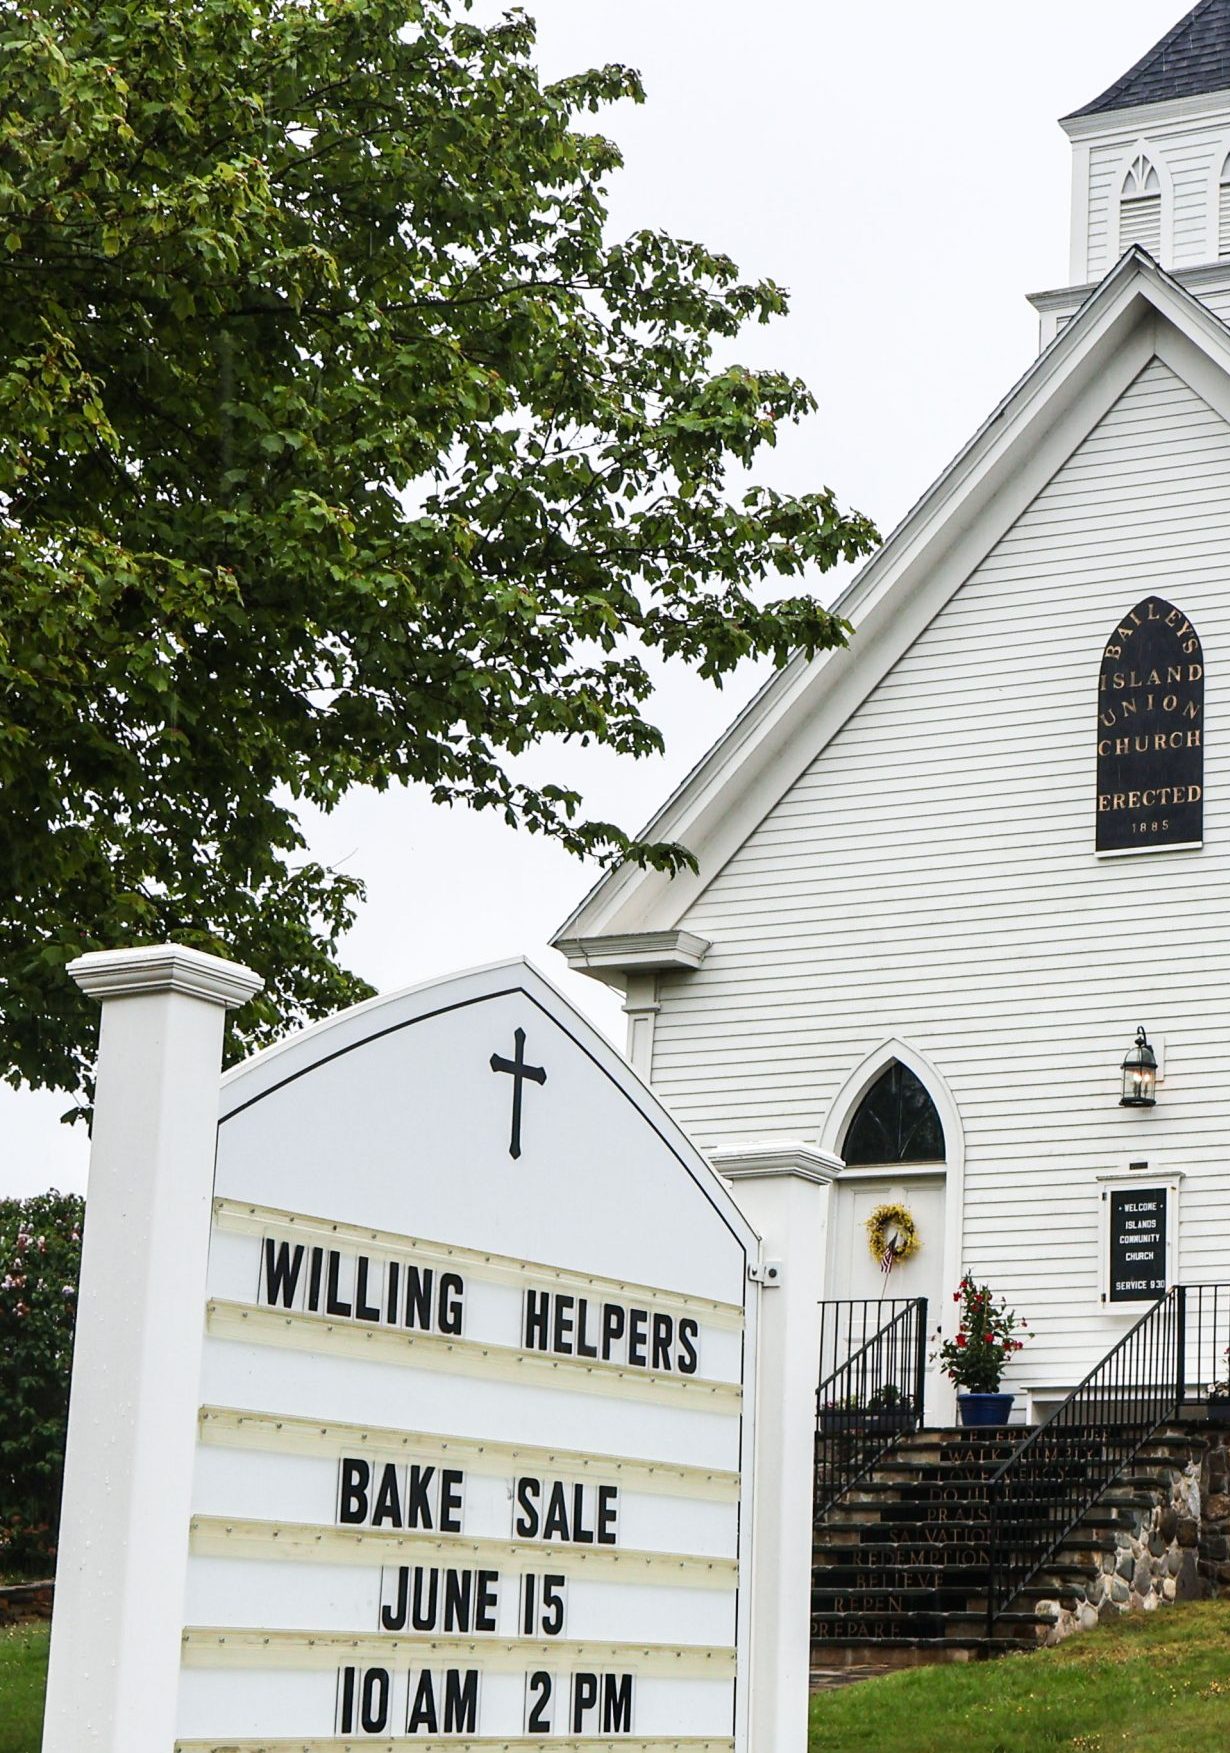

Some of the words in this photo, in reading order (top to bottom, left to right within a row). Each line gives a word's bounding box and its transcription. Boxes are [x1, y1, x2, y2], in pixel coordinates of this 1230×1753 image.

[1101, 664, 1203, 691] ISLAND
[1100, 694, 1200, 727] UNION
[1098, 730, 1201, 757] CHURCH
[1098, 785, 1202, 812] ERECTED
[1132, 819, 1169, 833] 1885
[1124, 1202, 1157, 1212] WELCOME
[1125, 1219, 1157, 1230] ISLANDS
[1119, 1233, 1160, 1244] COMMUNITY
[1125, 1251, 1154, 1261] CHURCH
[1115, 1279, 1147, 1290] SERVICE
[265, 1237, 463, 1336] WILLING
[526, 1289, 698, 1374] HELPERS
[339, 1457, 464, 1533] BAKE
[516, 1477, 618, 1544] SALE
[930, 1488, 958, 1500] DO
[927, 1508, 994, 1521] PRAIS
[852, 1550, 991, 1564] REDEMPTION
[856, 1573, 944, 1588] BELIEVE
[381, 1565, 499, 1632] JUNE
[524, 1573, 565, 1636] 15
[341, 1666, 389, 1733] 10
[407, 1668, 478, 1734] AM
[528, 1670, 552, 1733] 2
[573, 1672, 632, 1734] PM
